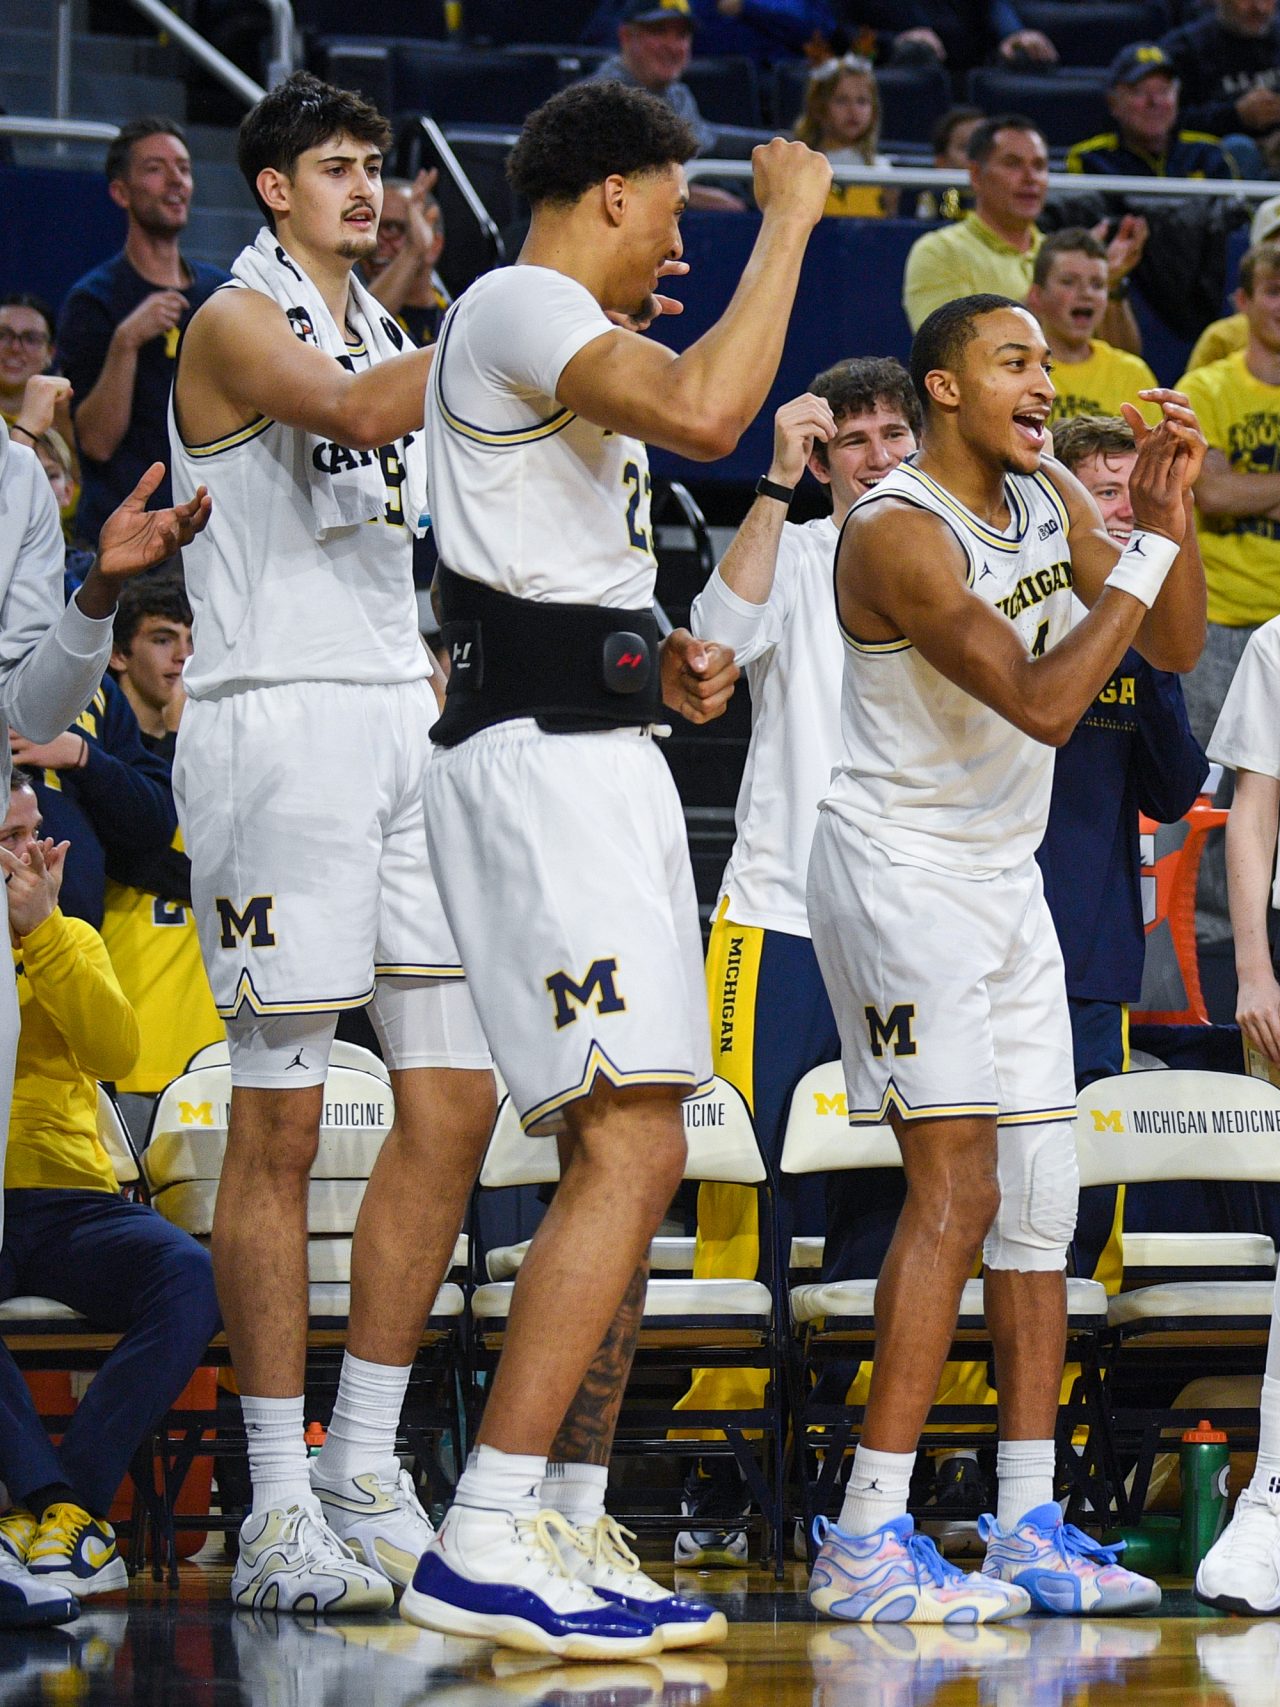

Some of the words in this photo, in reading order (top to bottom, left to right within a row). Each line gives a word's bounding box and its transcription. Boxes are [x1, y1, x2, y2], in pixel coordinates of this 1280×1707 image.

[621, 457, 653, 553] 2
[214, 895, 276, 950] M
[544, 954, 628, 1032] M
[720, 936, 744, 1055] MICHIGAN
[863, 1003, 918, 1058] M
[178, 1101, 214, 1126] M
[812, 1092, 850, 1117] M
[1089, 1110, 1125, 1133] M
[1133, 1110, 1208, 1134] MICHIGAN
